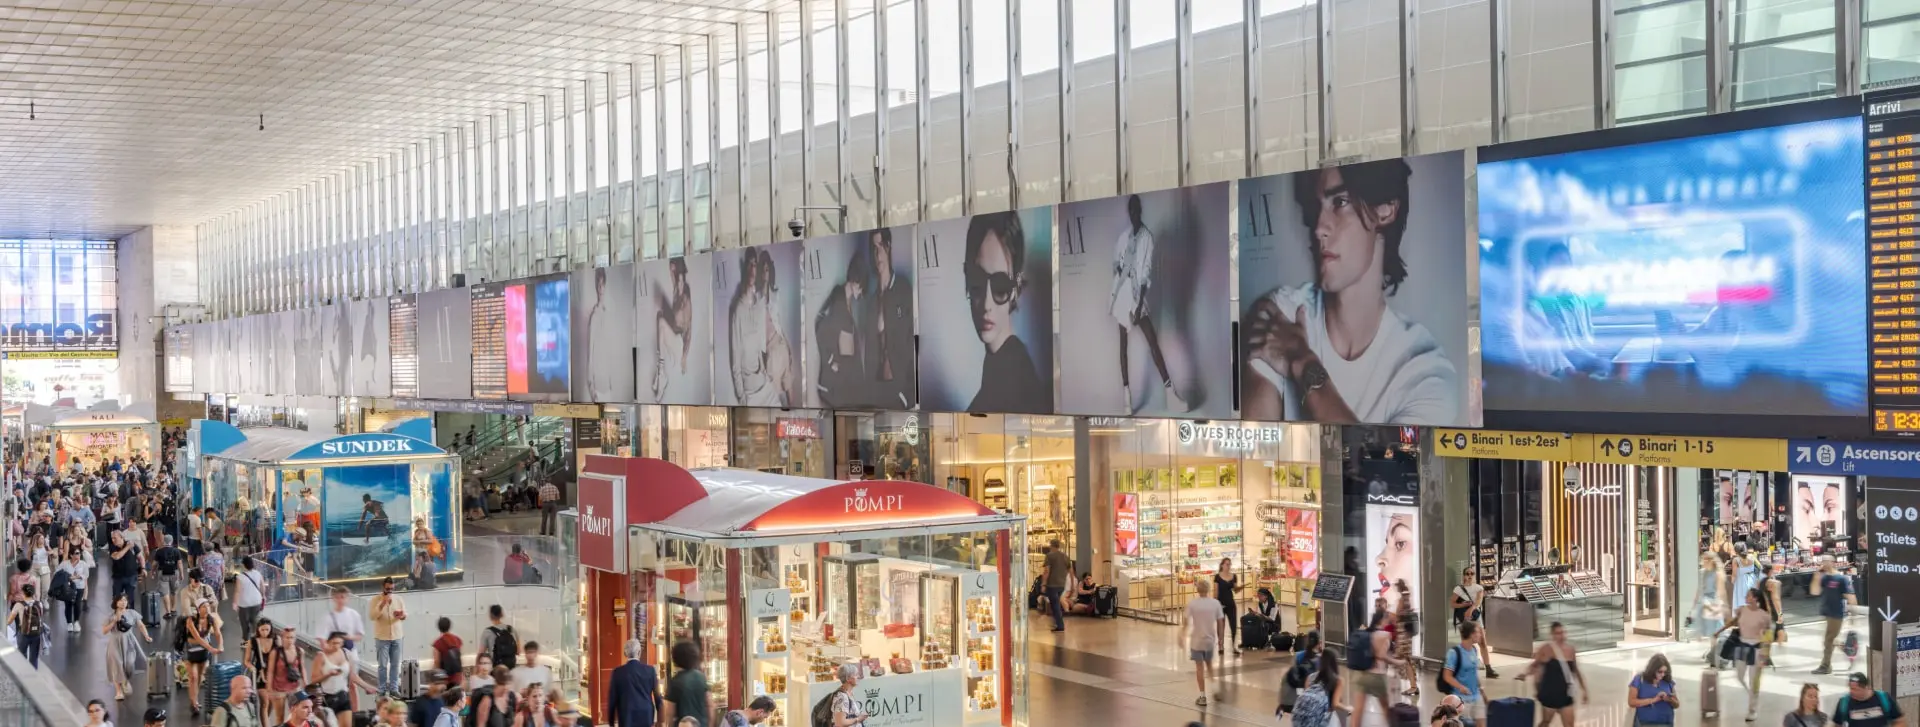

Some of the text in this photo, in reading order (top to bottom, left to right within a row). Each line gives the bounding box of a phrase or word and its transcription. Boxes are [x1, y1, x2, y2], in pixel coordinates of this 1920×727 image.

[1869, 101, 1901, 116] Arrivi
[1892, 412, 1920, 429] 12:3
[1194, 427, 1279, 441] YVES ROCHER
[1472, 433, 1559, 447] Binari 1est-2est
[322, 439, 412, 454] SUNDEK
[1472, 447, 1499, 456] Platforms
[1639, 438, 1714, 453] Binari 1-15
[1639, 453, 1671, 463] Platforms
[1842, 444, 1920, 462] Ascensore
[850, 465, 861, 473] 20
[1842, 460, 1855, 472] Lift
[844, 494, 905, 513] POMPI
[582, 513, 611, 537] POMPI
[1116, 519, 1136, 531] -50%
[1290, 537, 1313, 551] -50%
[1875, 532, 1917, 546] Toilets
[1876, 547, 1888, 558] al
[1876, 559, 1909, 573] piano
